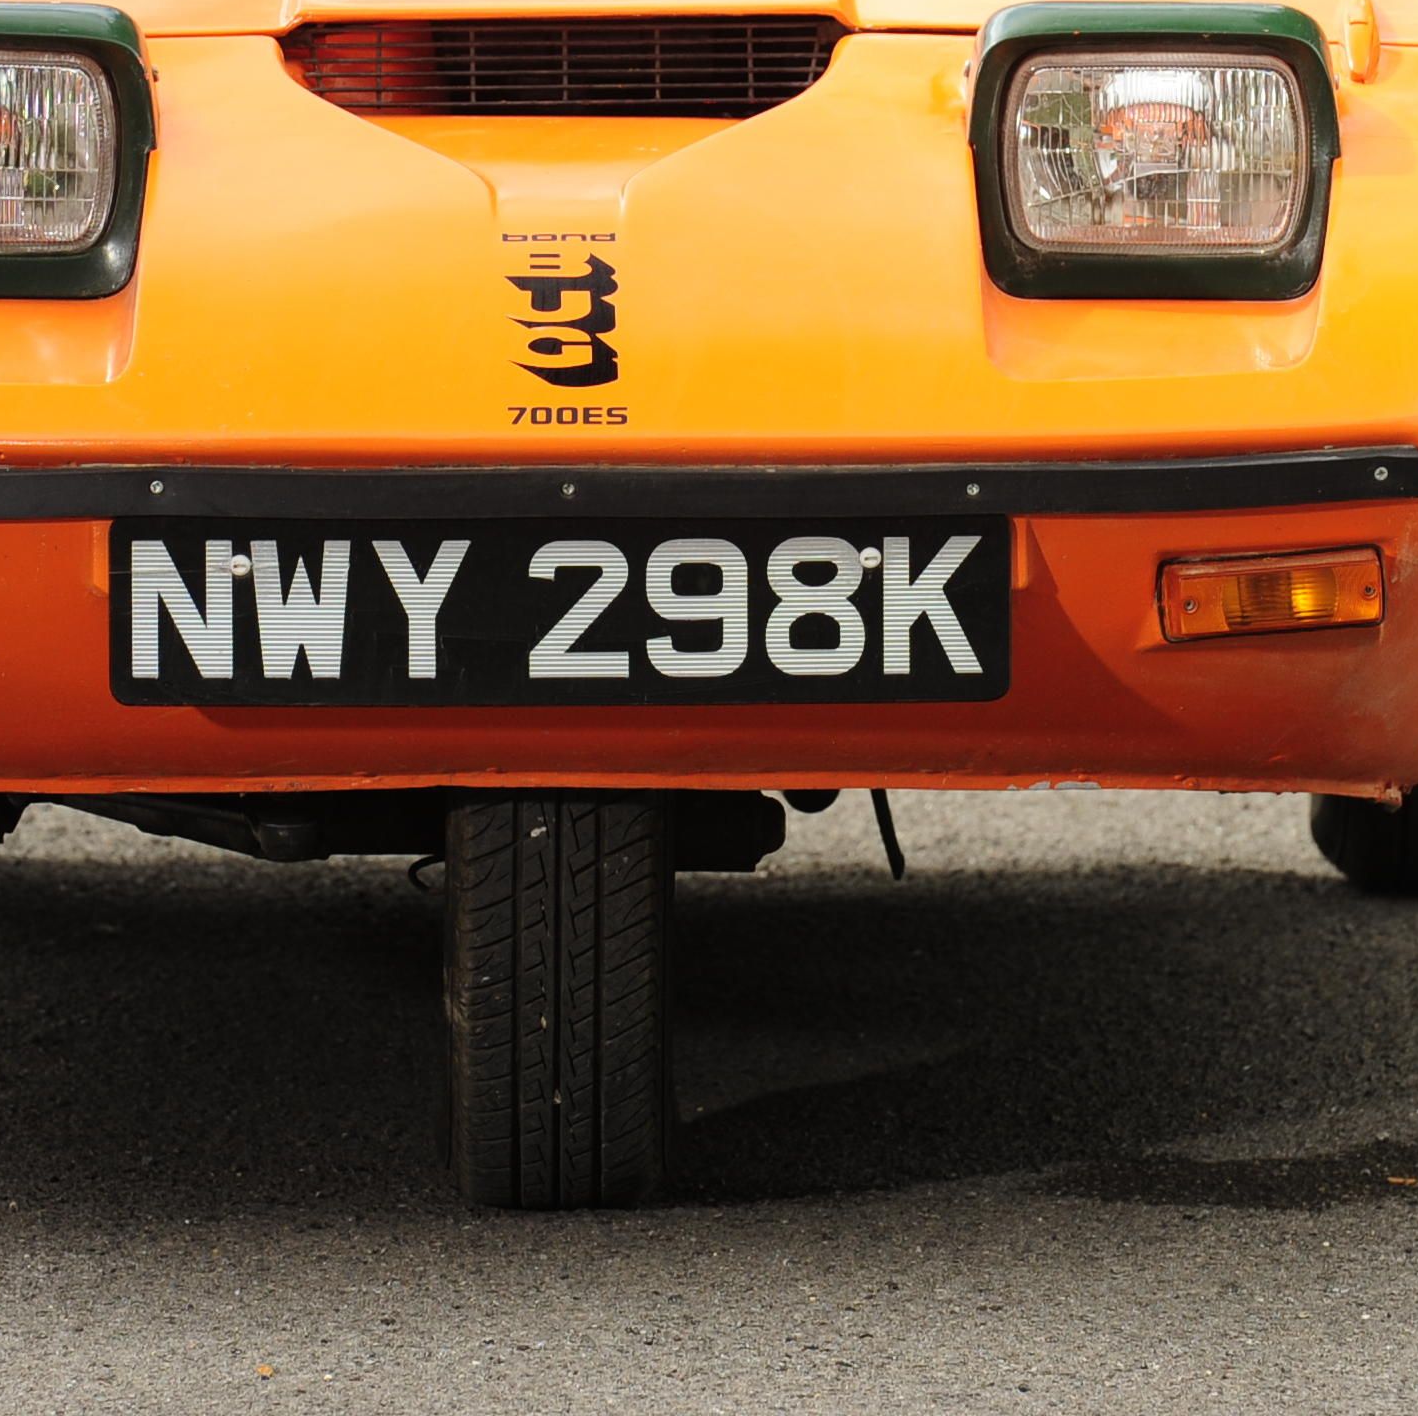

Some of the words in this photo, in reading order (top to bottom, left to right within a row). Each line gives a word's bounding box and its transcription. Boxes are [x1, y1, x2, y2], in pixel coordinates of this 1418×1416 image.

[502, 232, 616, 242] bond
[507, 407, 628, 425] 700ES
[130, 539, 472, 680] NWY
[527, 535, 984, 679] 298K
